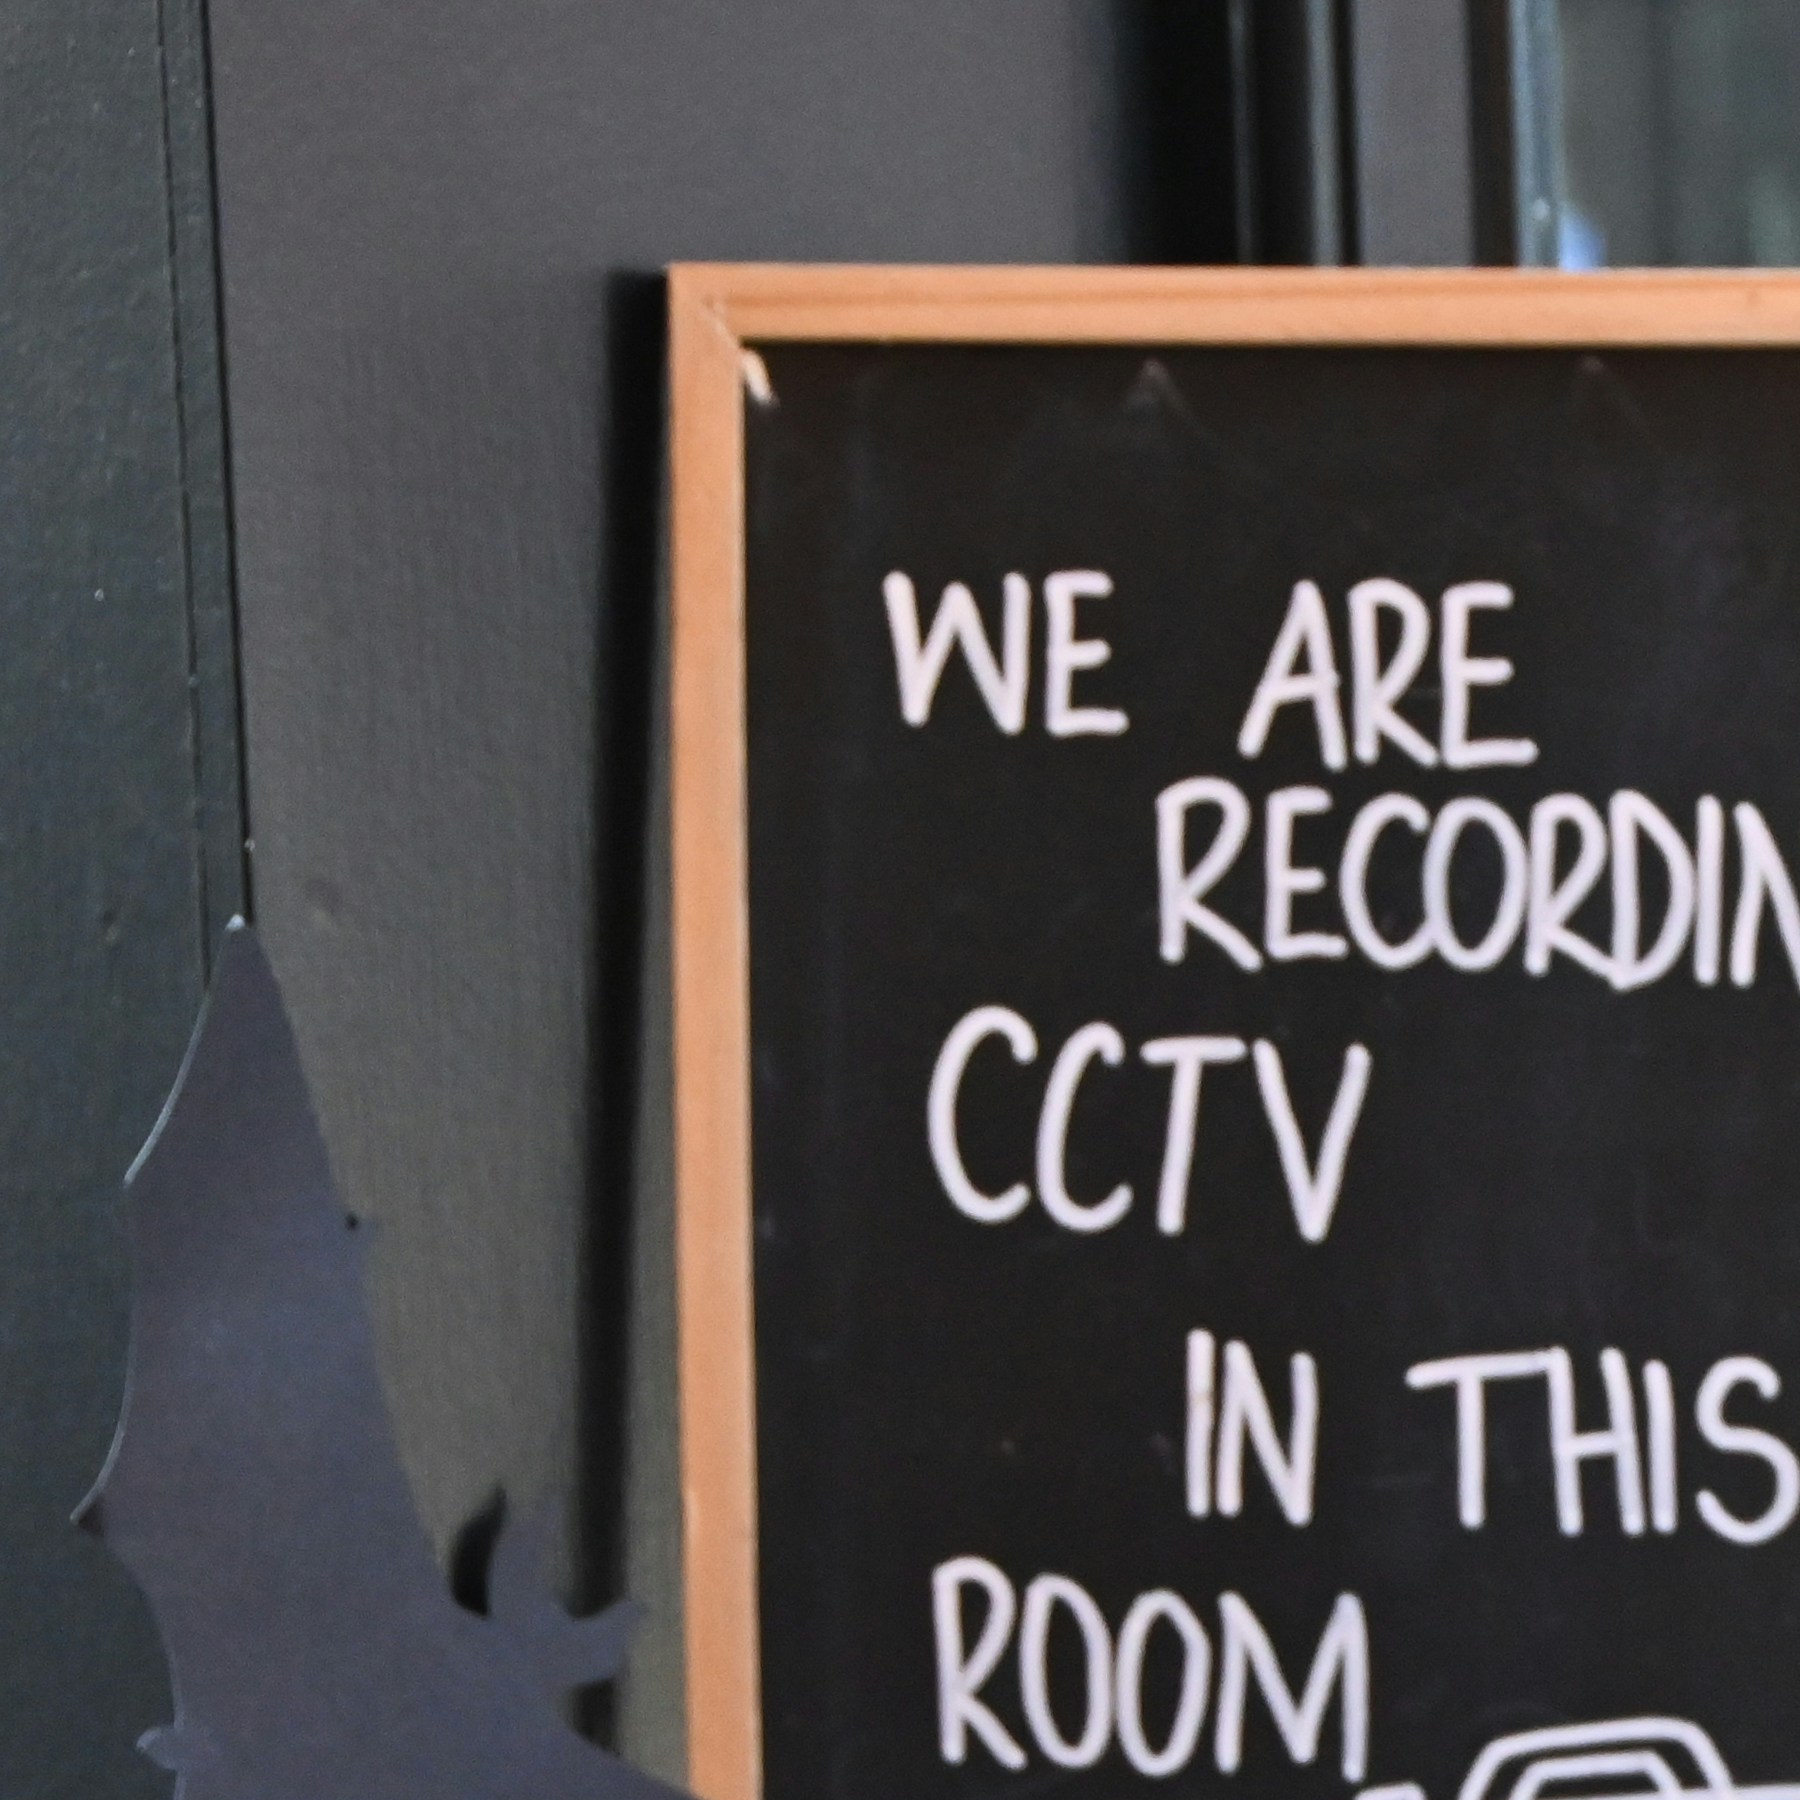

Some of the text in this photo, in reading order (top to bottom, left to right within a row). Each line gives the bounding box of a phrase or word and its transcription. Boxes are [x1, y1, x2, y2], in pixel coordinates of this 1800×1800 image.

[884, 571, 1537, 769] WE ARE
[928, 1006, 1370, 1241] CCTV
[1187, 1330, 1800, 1543] IN THIS
[933, 1557, 1368, 1782] ROOM
